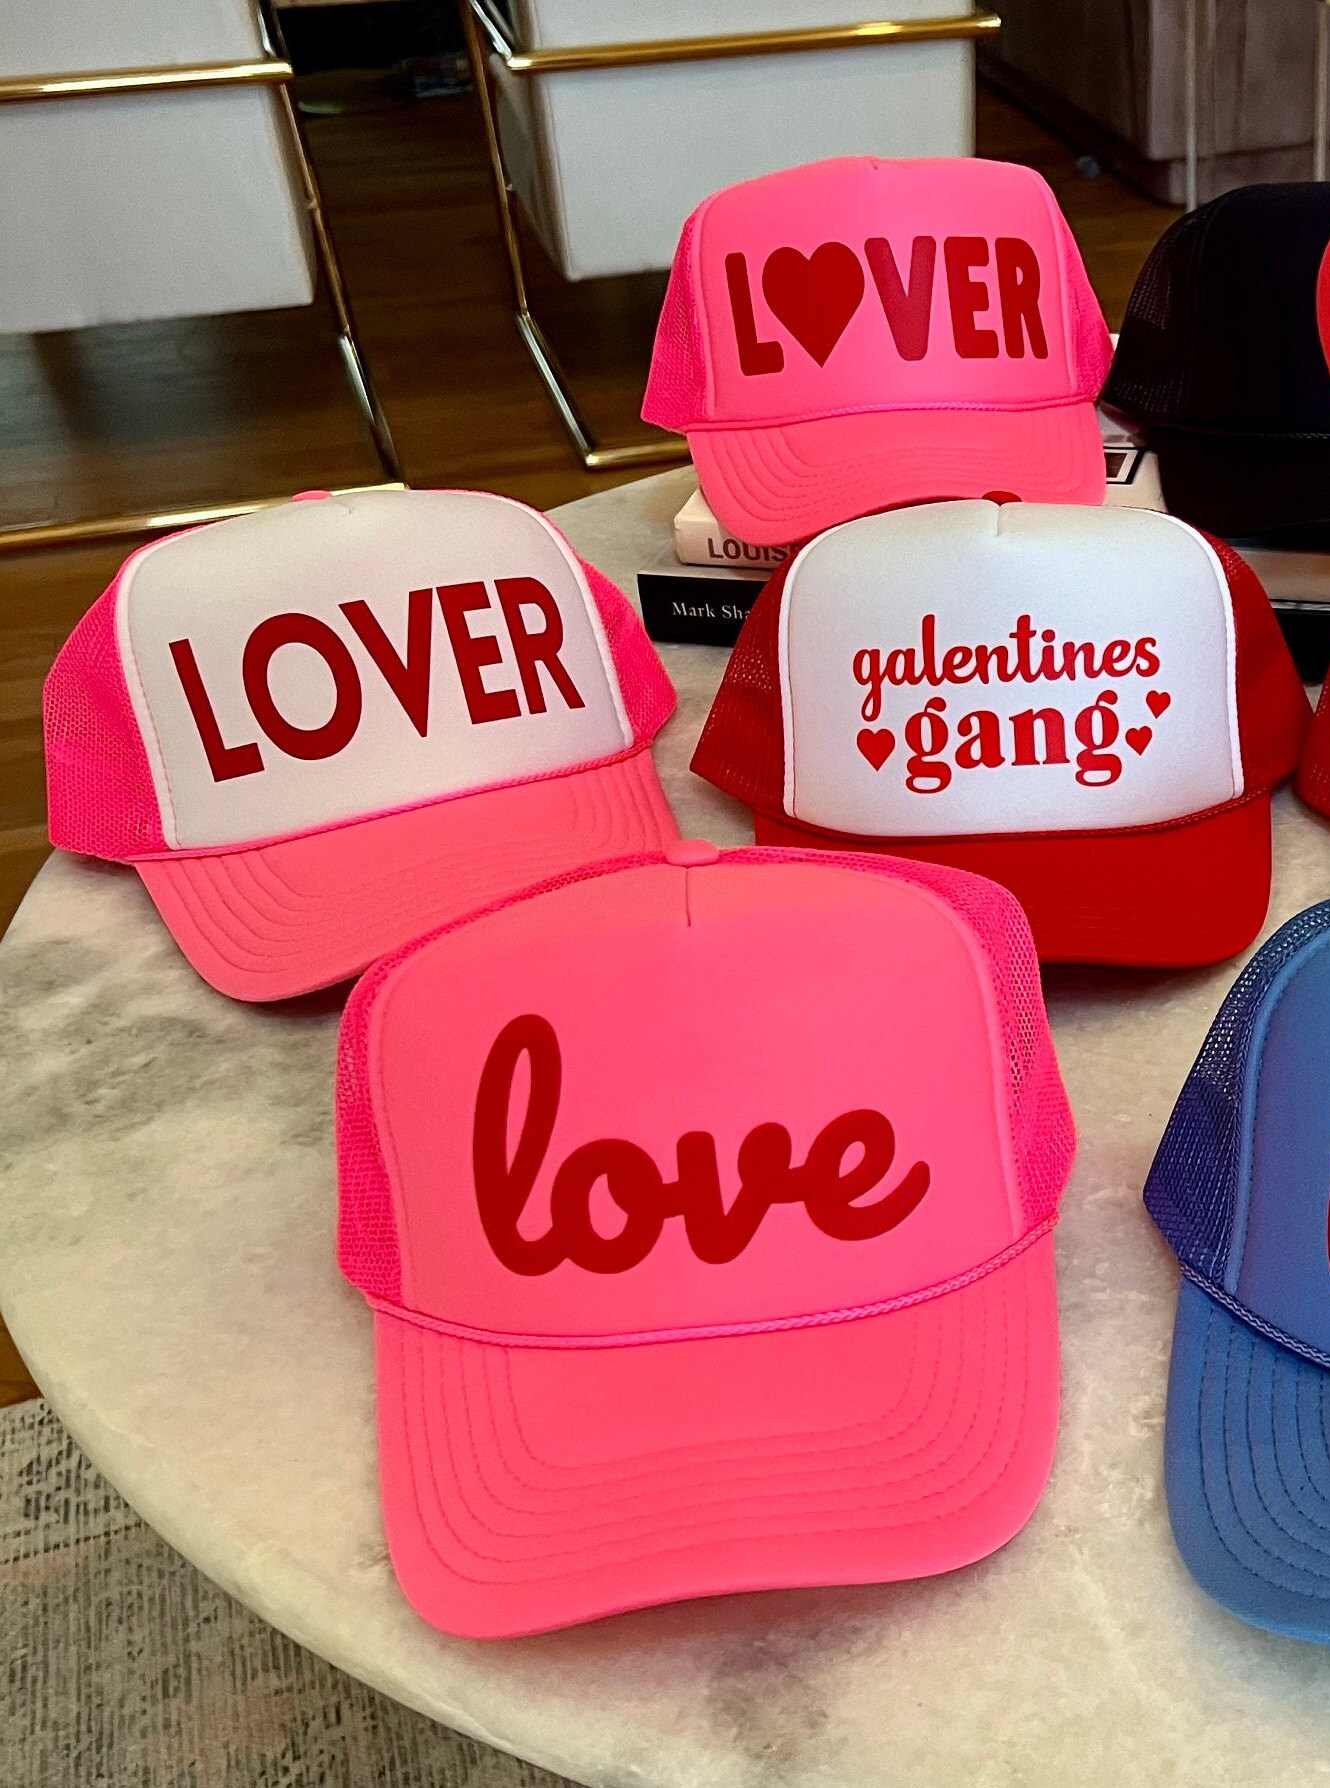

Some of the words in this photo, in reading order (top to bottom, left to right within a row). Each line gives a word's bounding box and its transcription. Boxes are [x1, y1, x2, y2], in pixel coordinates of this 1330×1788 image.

[672, 601, 715, 618] Mark
[168, 576, 585, 783] LOVER
[852, 613, 1161, 722] galentines
[904, 689, 1123, 795] gang
[472, 1013, 931, 1277] love
